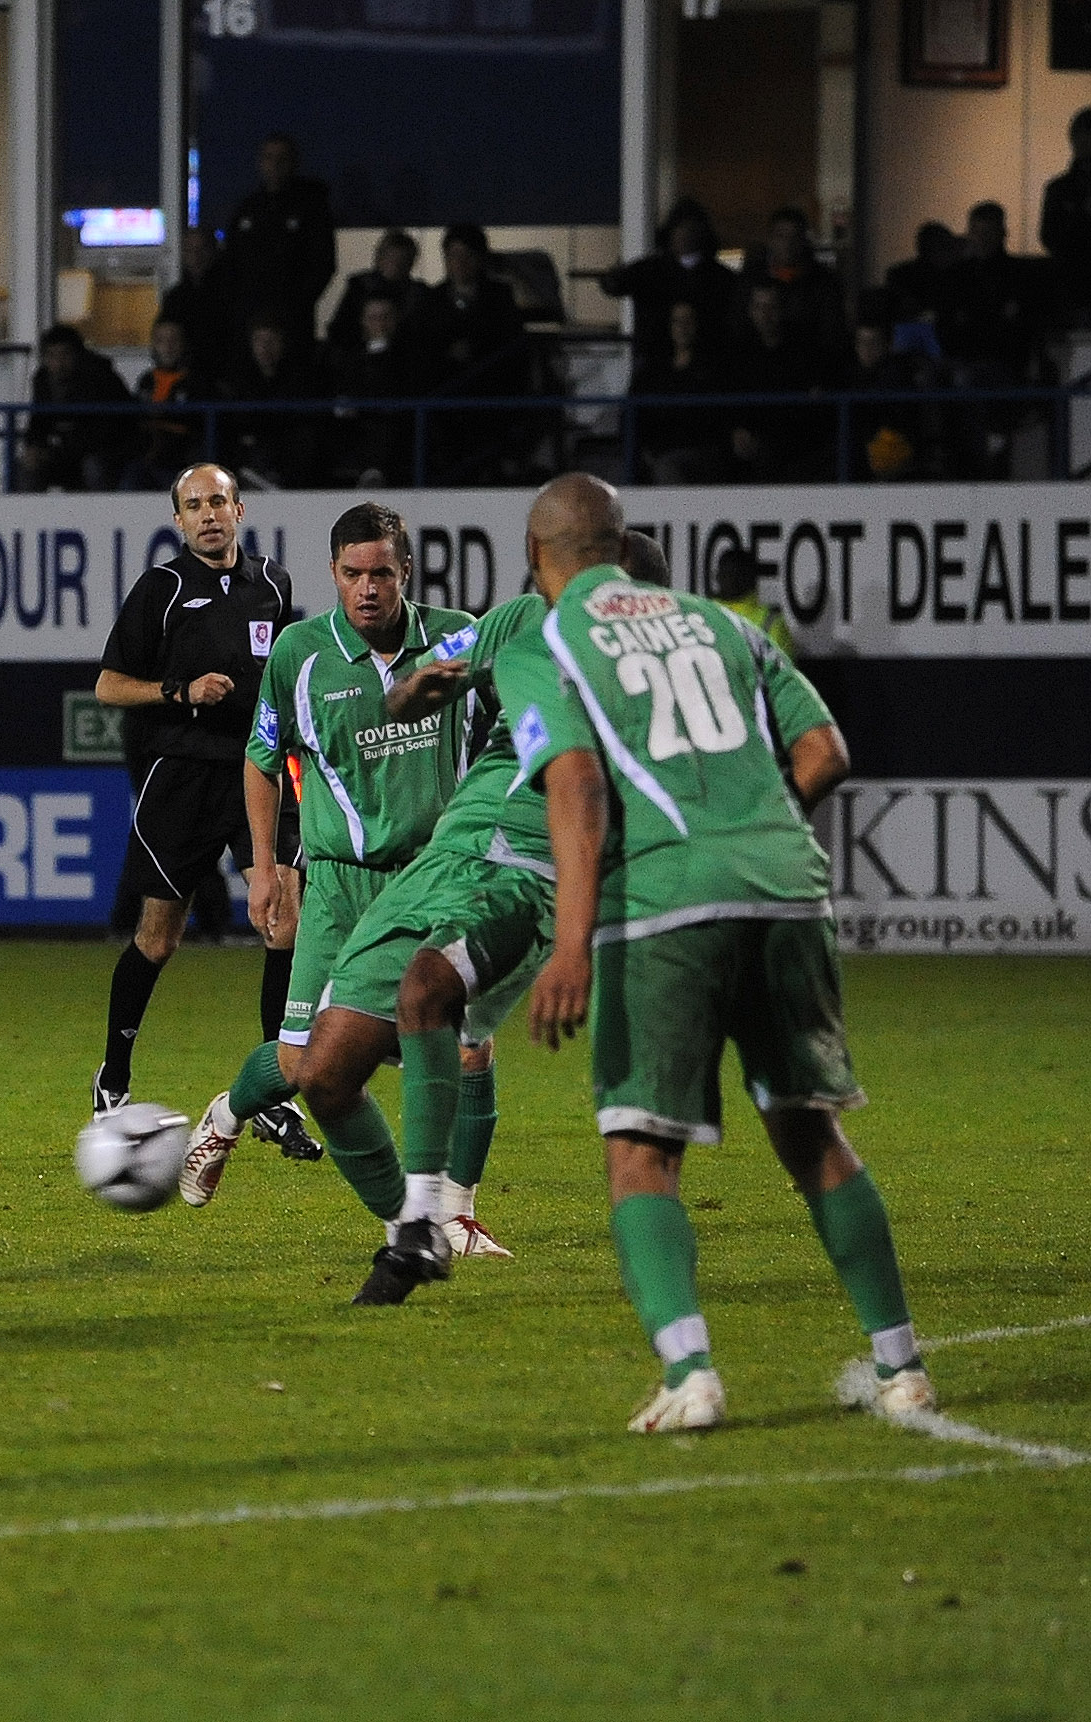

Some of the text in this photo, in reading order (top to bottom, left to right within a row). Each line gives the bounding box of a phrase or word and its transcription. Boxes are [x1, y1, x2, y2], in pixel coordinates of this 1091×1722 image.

[205, 0, 258, 37] 16
[404, 526, 496, 620] RD
[588, 612, 716, 659] CAINES
[616, 644, 749, 762] 20
[73, 706, 127, 748] EX
[363, 744, 405, 761] Building
